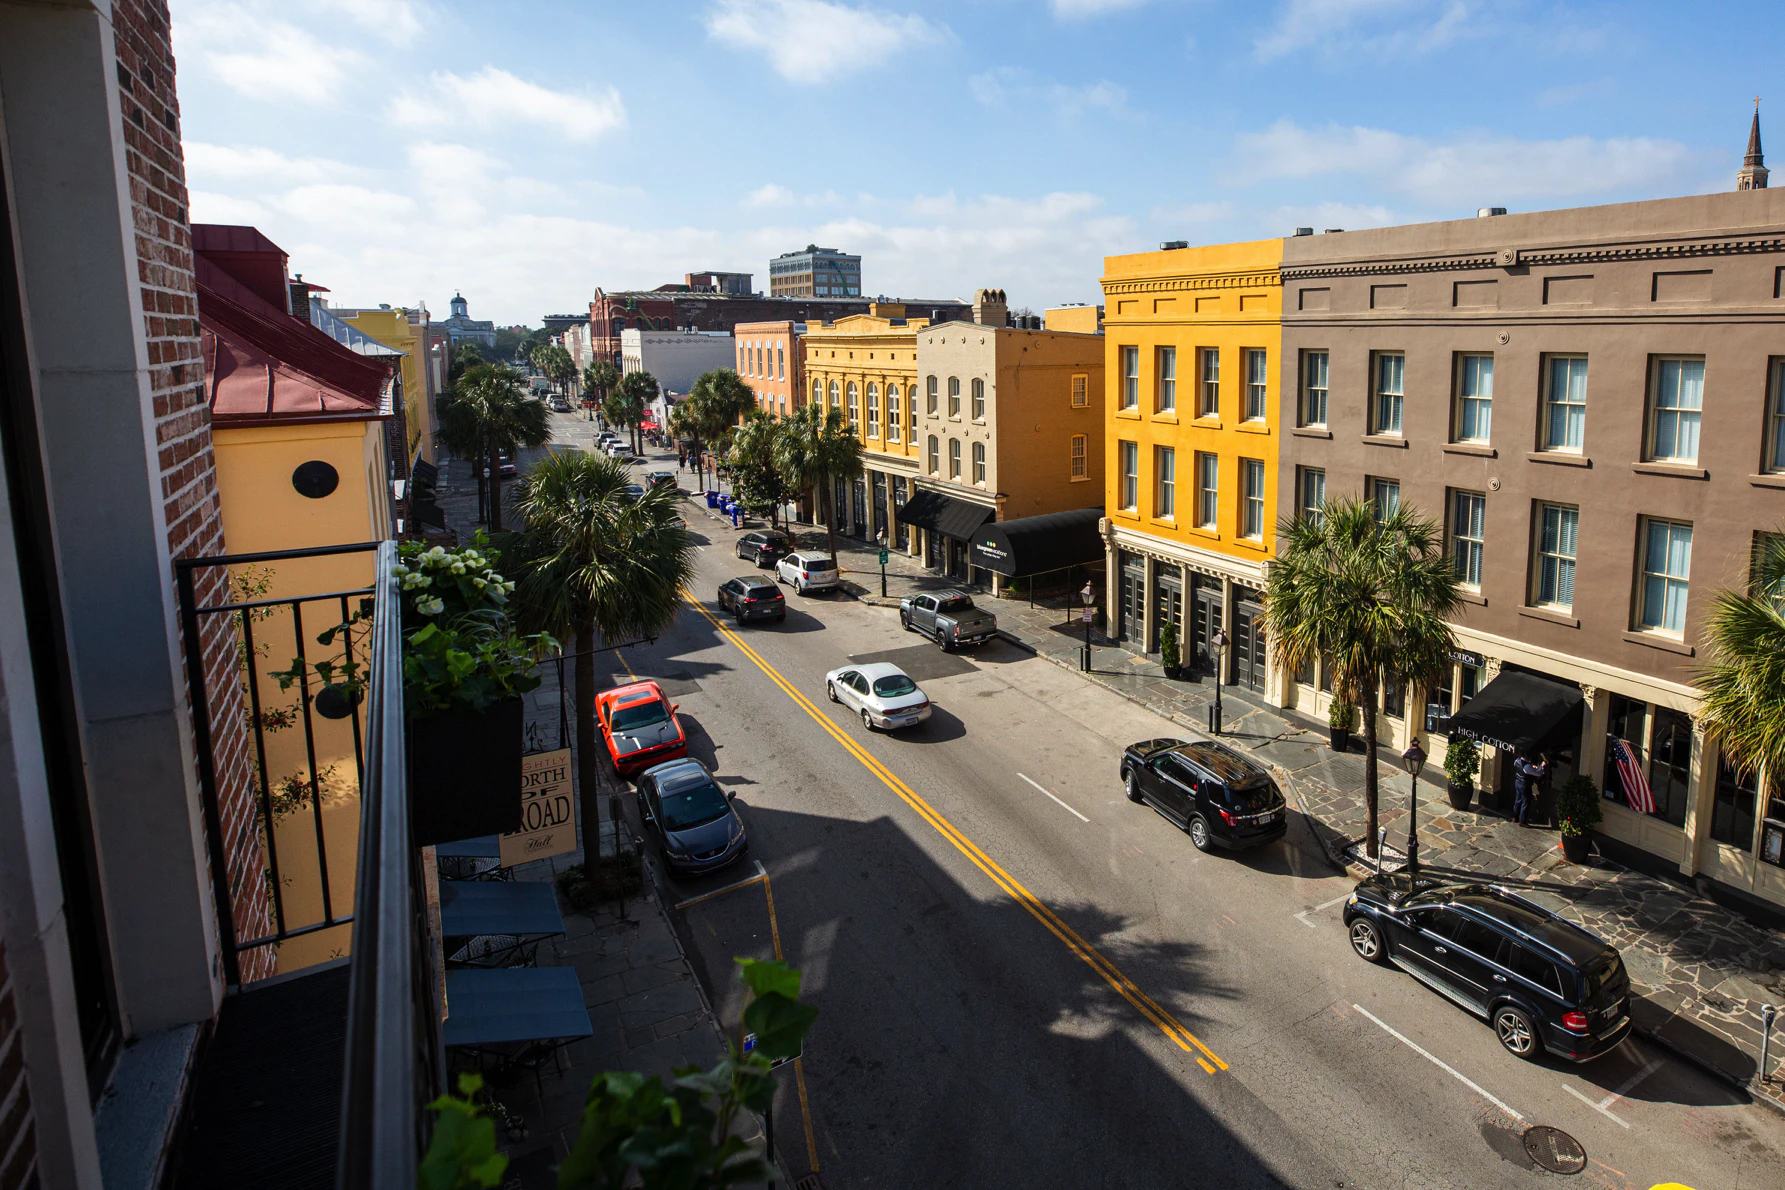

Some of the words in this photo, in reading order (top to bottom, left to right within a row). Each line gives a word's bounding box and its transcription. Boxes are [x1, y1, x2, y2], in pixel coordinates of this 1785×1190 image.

[1457, 726, 1479, 740] HIGH
[1482, 735, 1516, 753] COTTON
[522, 756, 567, 771] GHTLY
[521, 767, 567, 789] ORTH
[503, 795, 571, 837] ROAD
